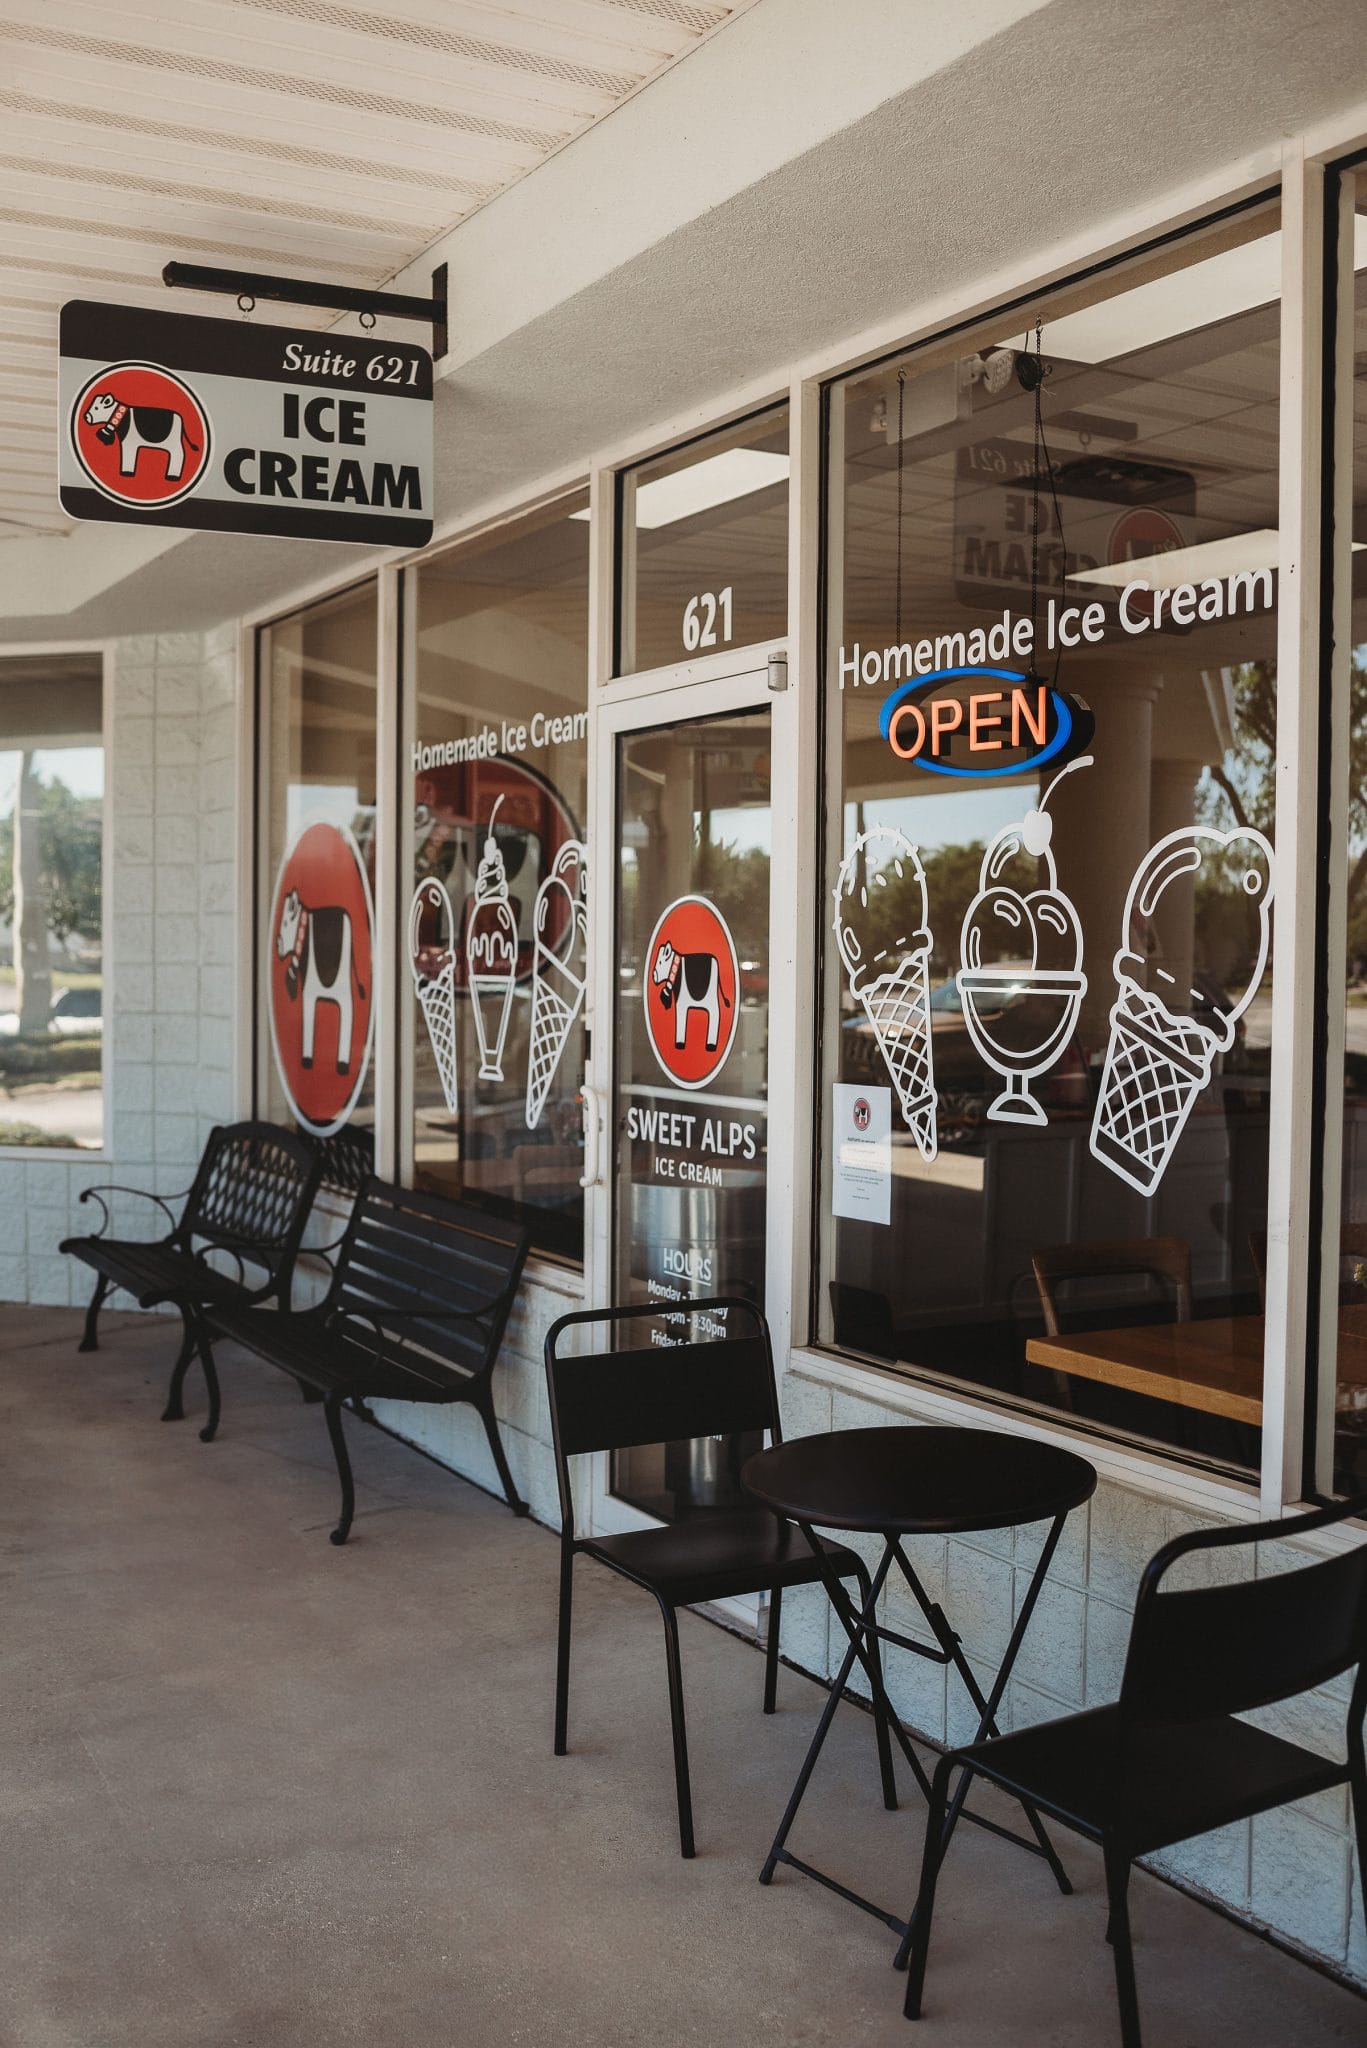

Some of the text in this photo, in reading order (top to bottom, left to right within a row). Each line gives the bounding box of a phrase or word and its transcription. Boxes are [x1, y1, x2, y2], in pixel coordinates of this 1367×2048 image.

[282, 343, 421, 386] Suite 621
[282, 392, 367, 446] ICE
[223, 447, 423, 511] CREAM
[682, 586, 733, 651] 621
[838, 567, 1273, 690] Homemade Ice Cream
[411, 712, 588, 771] Homemade Ice Cream
[889, 685, 1048, 760] OPEN
[627, 1106, 756, 1160] SWEET ALPS
[655, 1156, 723, 1187] ICE CREAM
[647, 1279, 681, 1301] Monday
[663, 1247, 712, 1281] HOURS
